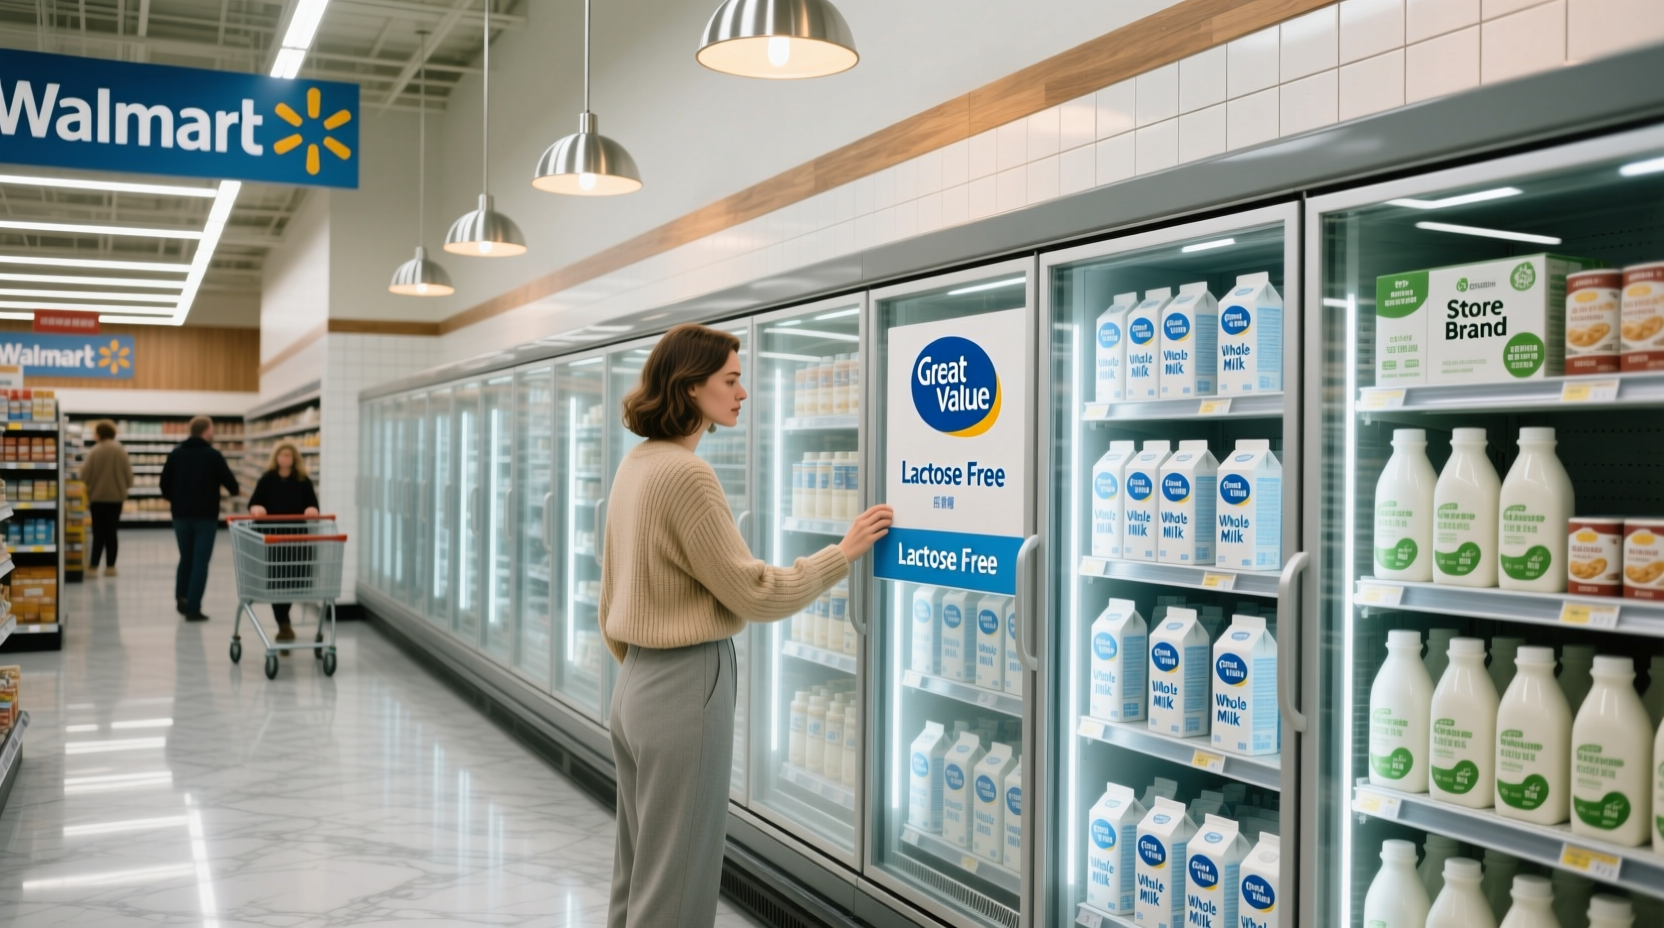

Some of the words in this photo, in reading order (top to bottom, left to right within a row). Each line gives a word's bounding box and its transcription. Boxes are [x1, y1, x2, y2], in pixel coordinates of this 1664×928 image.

[0, 79, 264, 156] Walmart
[1447, 299, 1504, 319] Store
[1445, 316, 1507, 340] Brand
[0, 342, 95, 369] Walmart
[1223, 356, 1246, 371] Milk
[917, 355, 967, 386] Great
[936, 385, 990, 412] Value
[902, 460, 962, 485] Lactose
[967, 461, 1005, 487] Free
[1220, 529, 1244, 543] Milk
[898, 542, 957, 570] Lactose
[961, 547, 998, 575] Free
[1216, 692, 1247, 710] Whole
[1217, 709, 1241, 726] Milk
